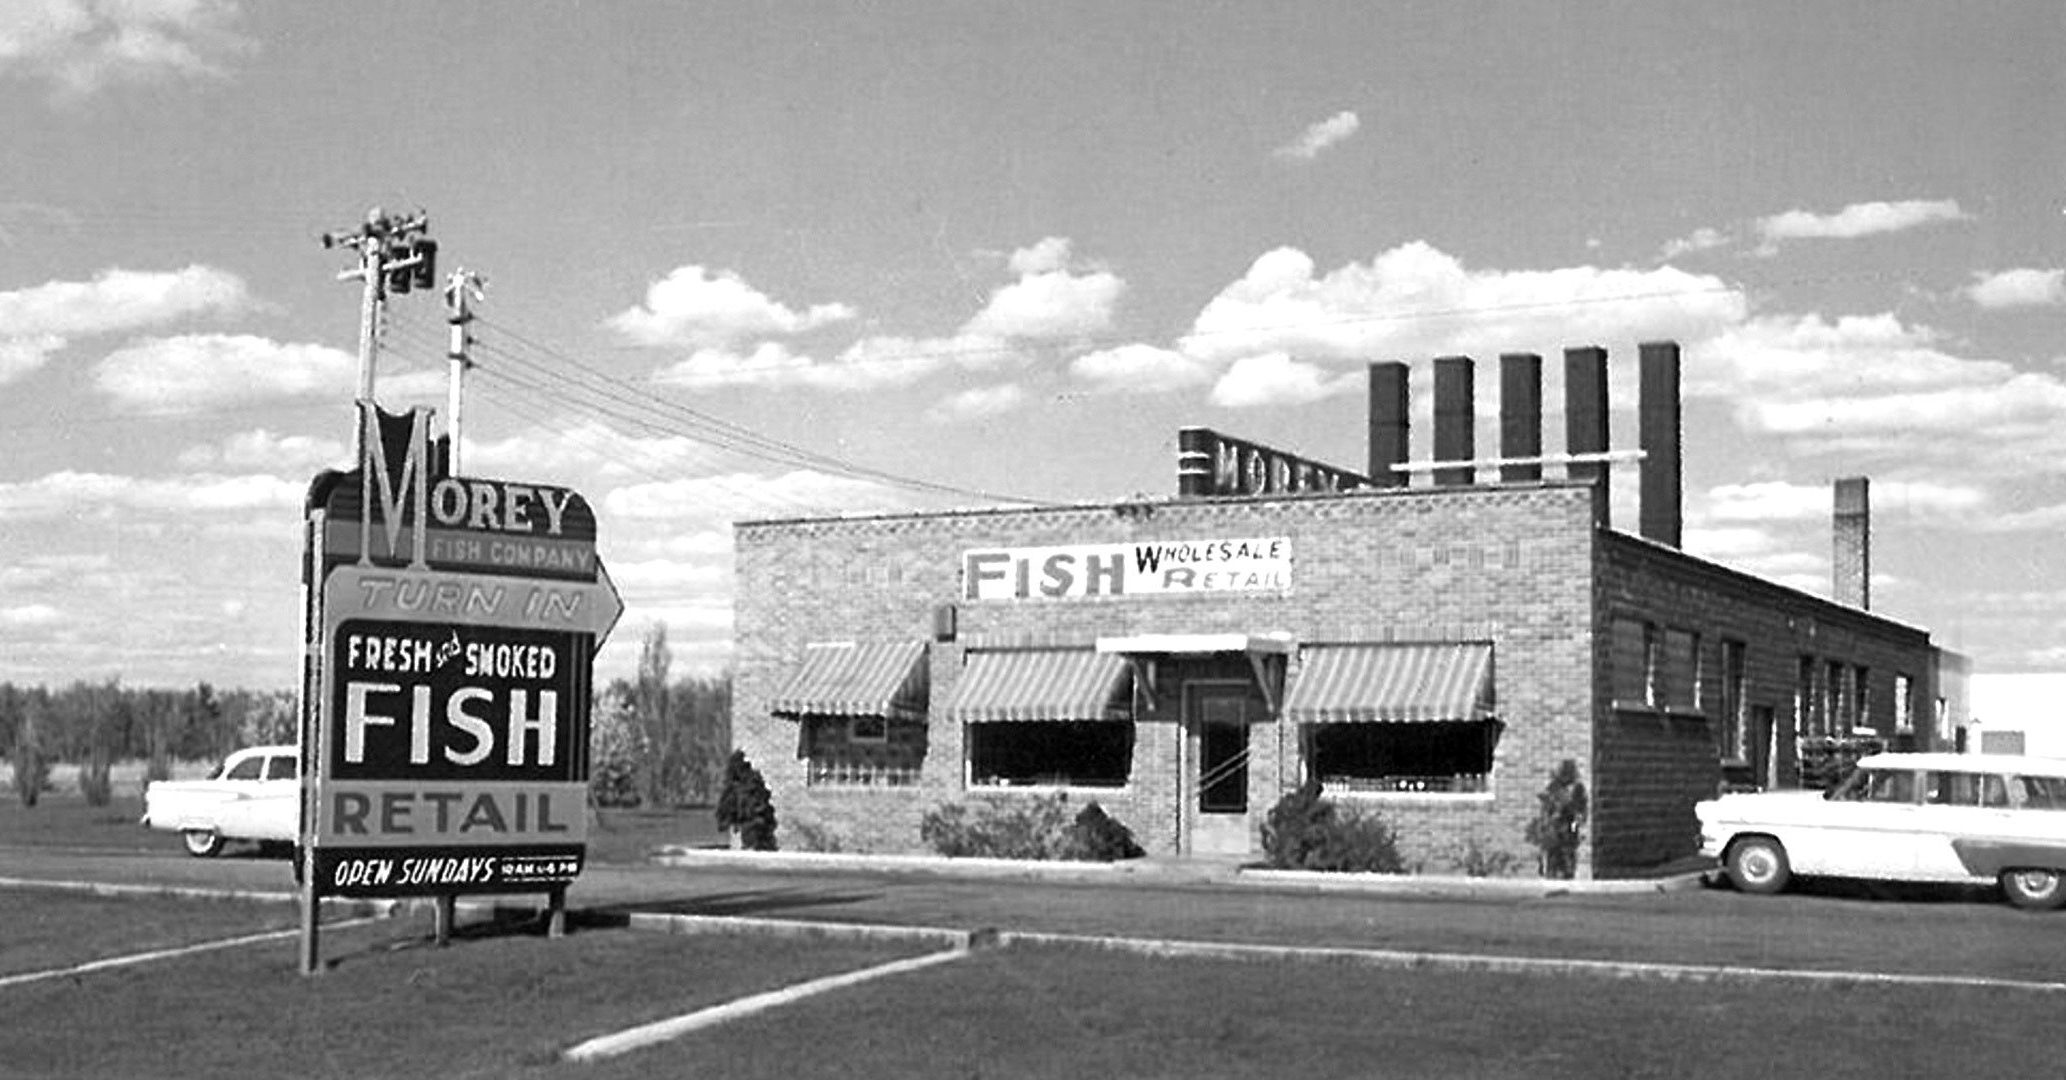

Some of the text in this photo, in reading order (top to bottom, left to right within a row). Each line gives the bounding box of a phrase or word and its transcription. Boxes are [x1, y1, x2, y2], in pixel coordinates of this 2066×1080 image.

[354, 399, 576, 571] MOREY
[432, 538, 590, 572] FISH COMPANY
[966, 540, 1282, 599] FISH WHOLESALE
[358, 577, 582, 622] TURN IN
[1162, 567, 1284, 589] RETAIL
[348, 636, 433, 672] FRESH
[465, 643, 557, 679] SMOKED
[345, 681, 558, 766] FISH
[333, 792, 569, 835] RETAIL
[335, 859, 394, 886] OPEN
[396, 857, 496, 884] SUNDAYS
